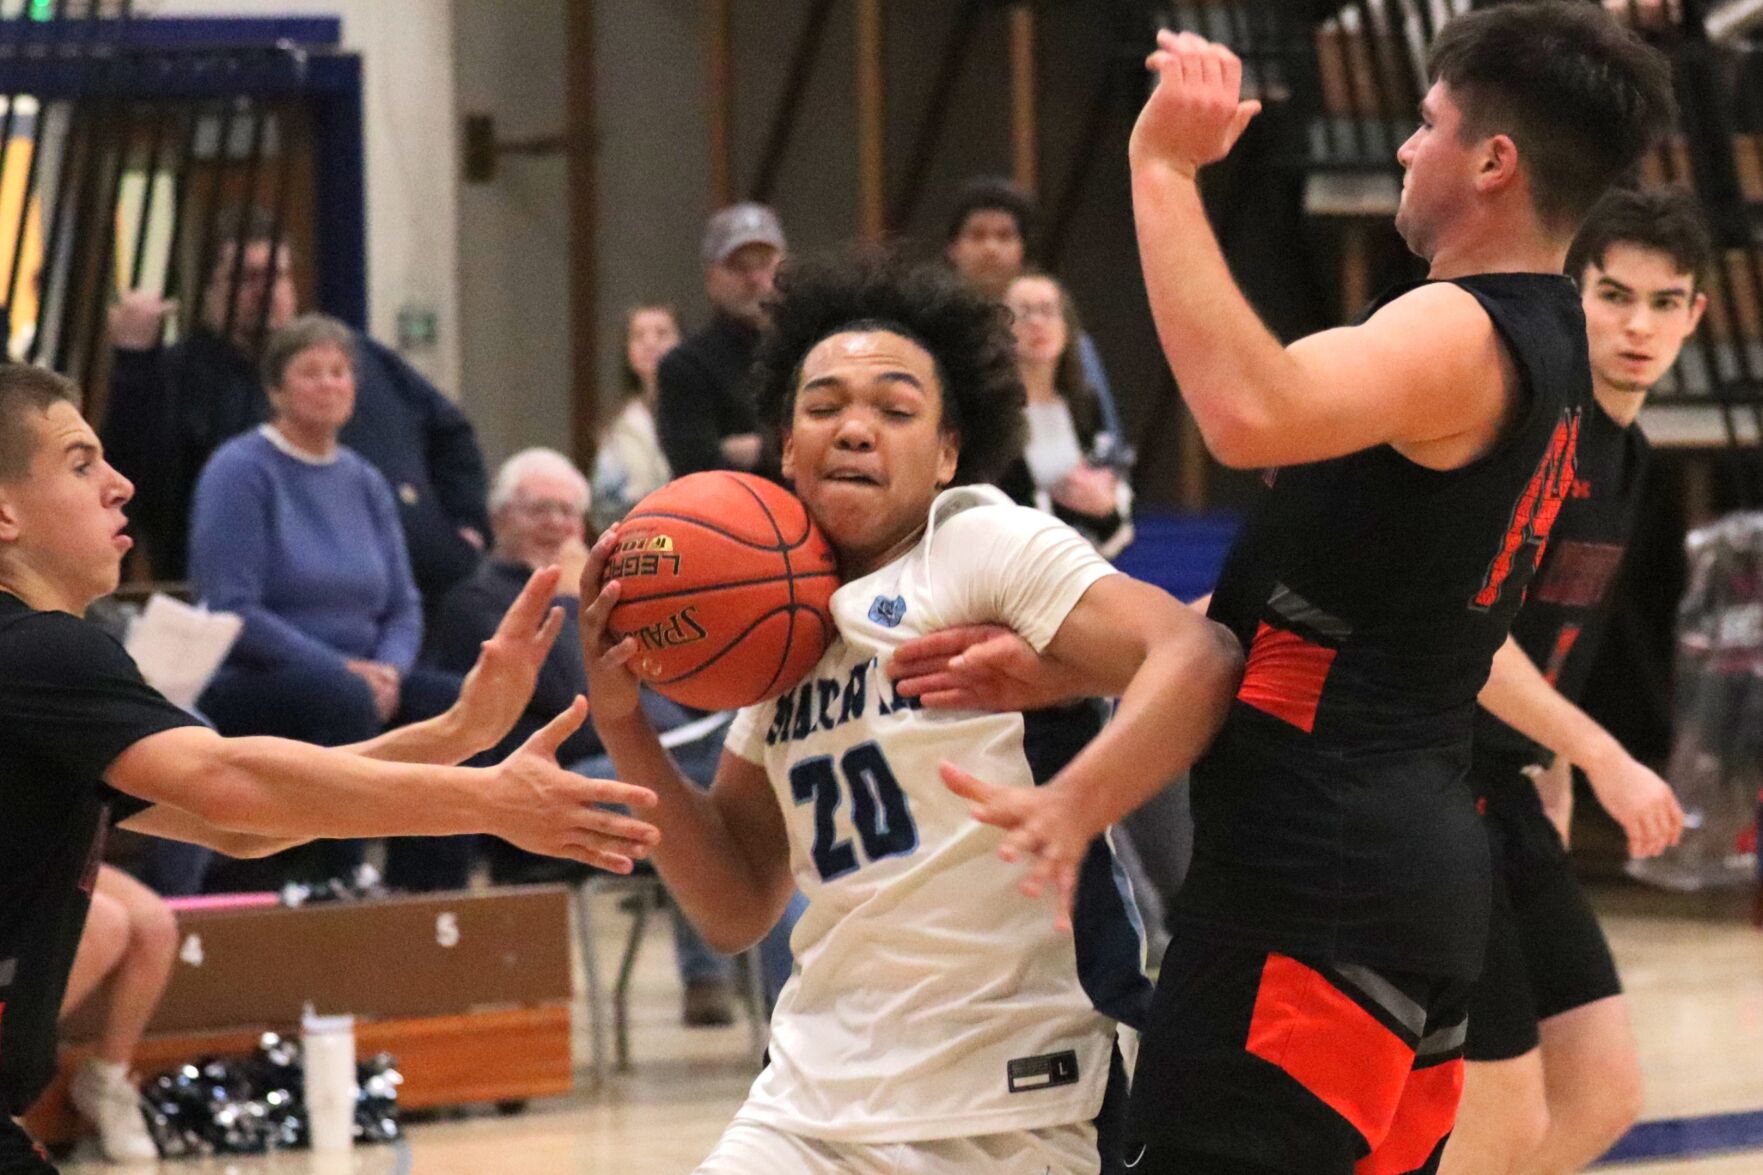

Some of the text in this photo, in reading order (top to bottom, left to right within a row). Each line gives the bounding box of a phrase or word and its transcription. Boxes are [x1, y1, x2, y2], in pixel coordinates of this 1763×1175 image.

[788, 738, 921, 884] 20
[436, 911, 460, 948] 5
[179, 933, 204, 967] 4
[1058, 1061, 1068, 1076] L
